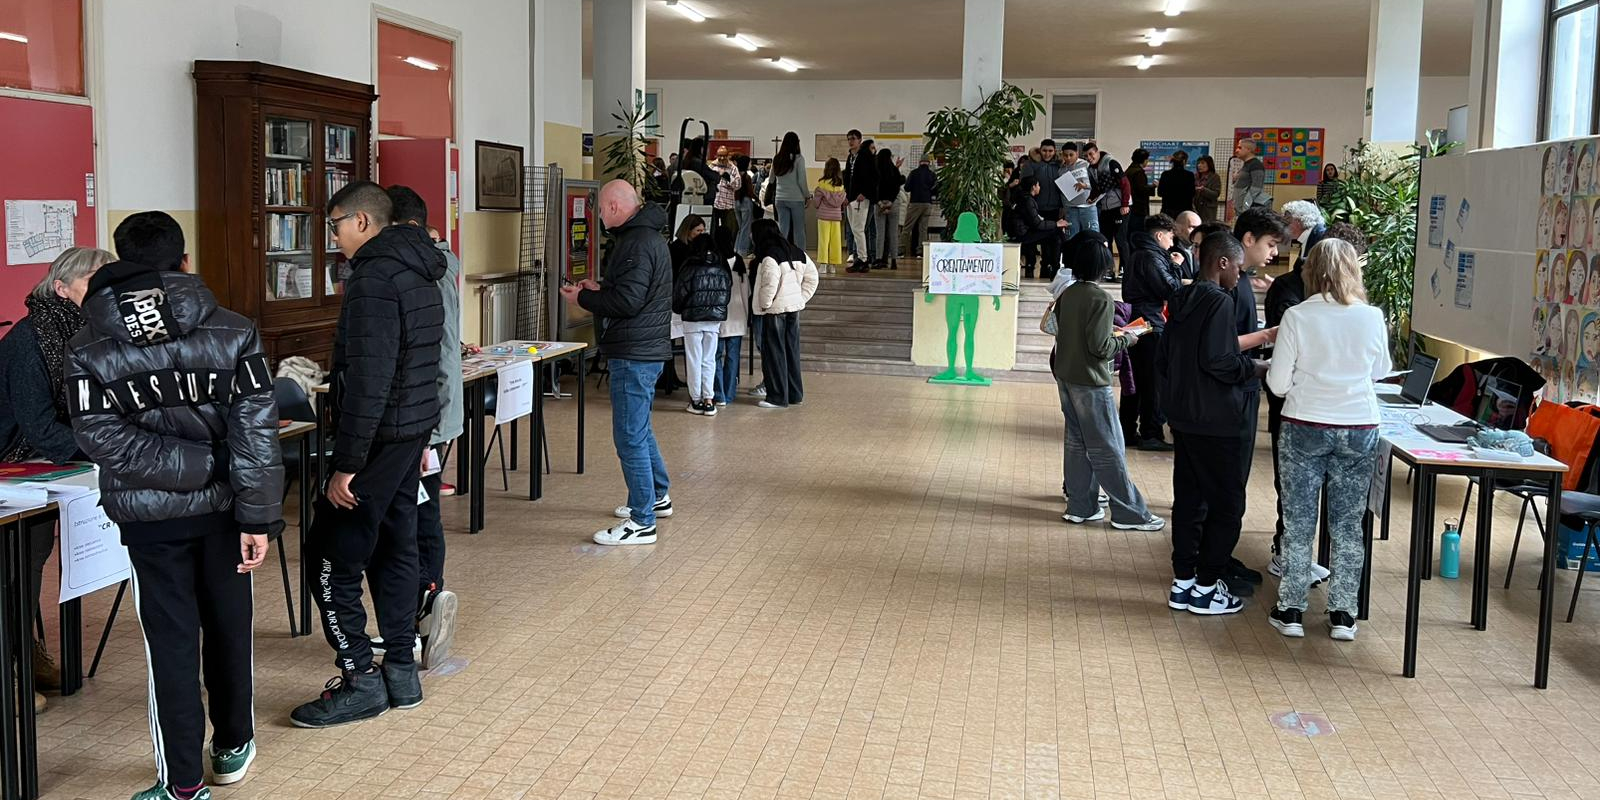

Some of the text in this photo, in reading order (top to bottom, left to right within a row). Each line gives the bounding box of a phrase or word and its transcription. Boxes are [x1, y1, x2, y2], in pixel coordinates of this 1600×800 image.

[124, 314, 143, 338] DES
[319, 558, 332, 602] AIR JORDAN
[326, 610, 338, 625] AIR
